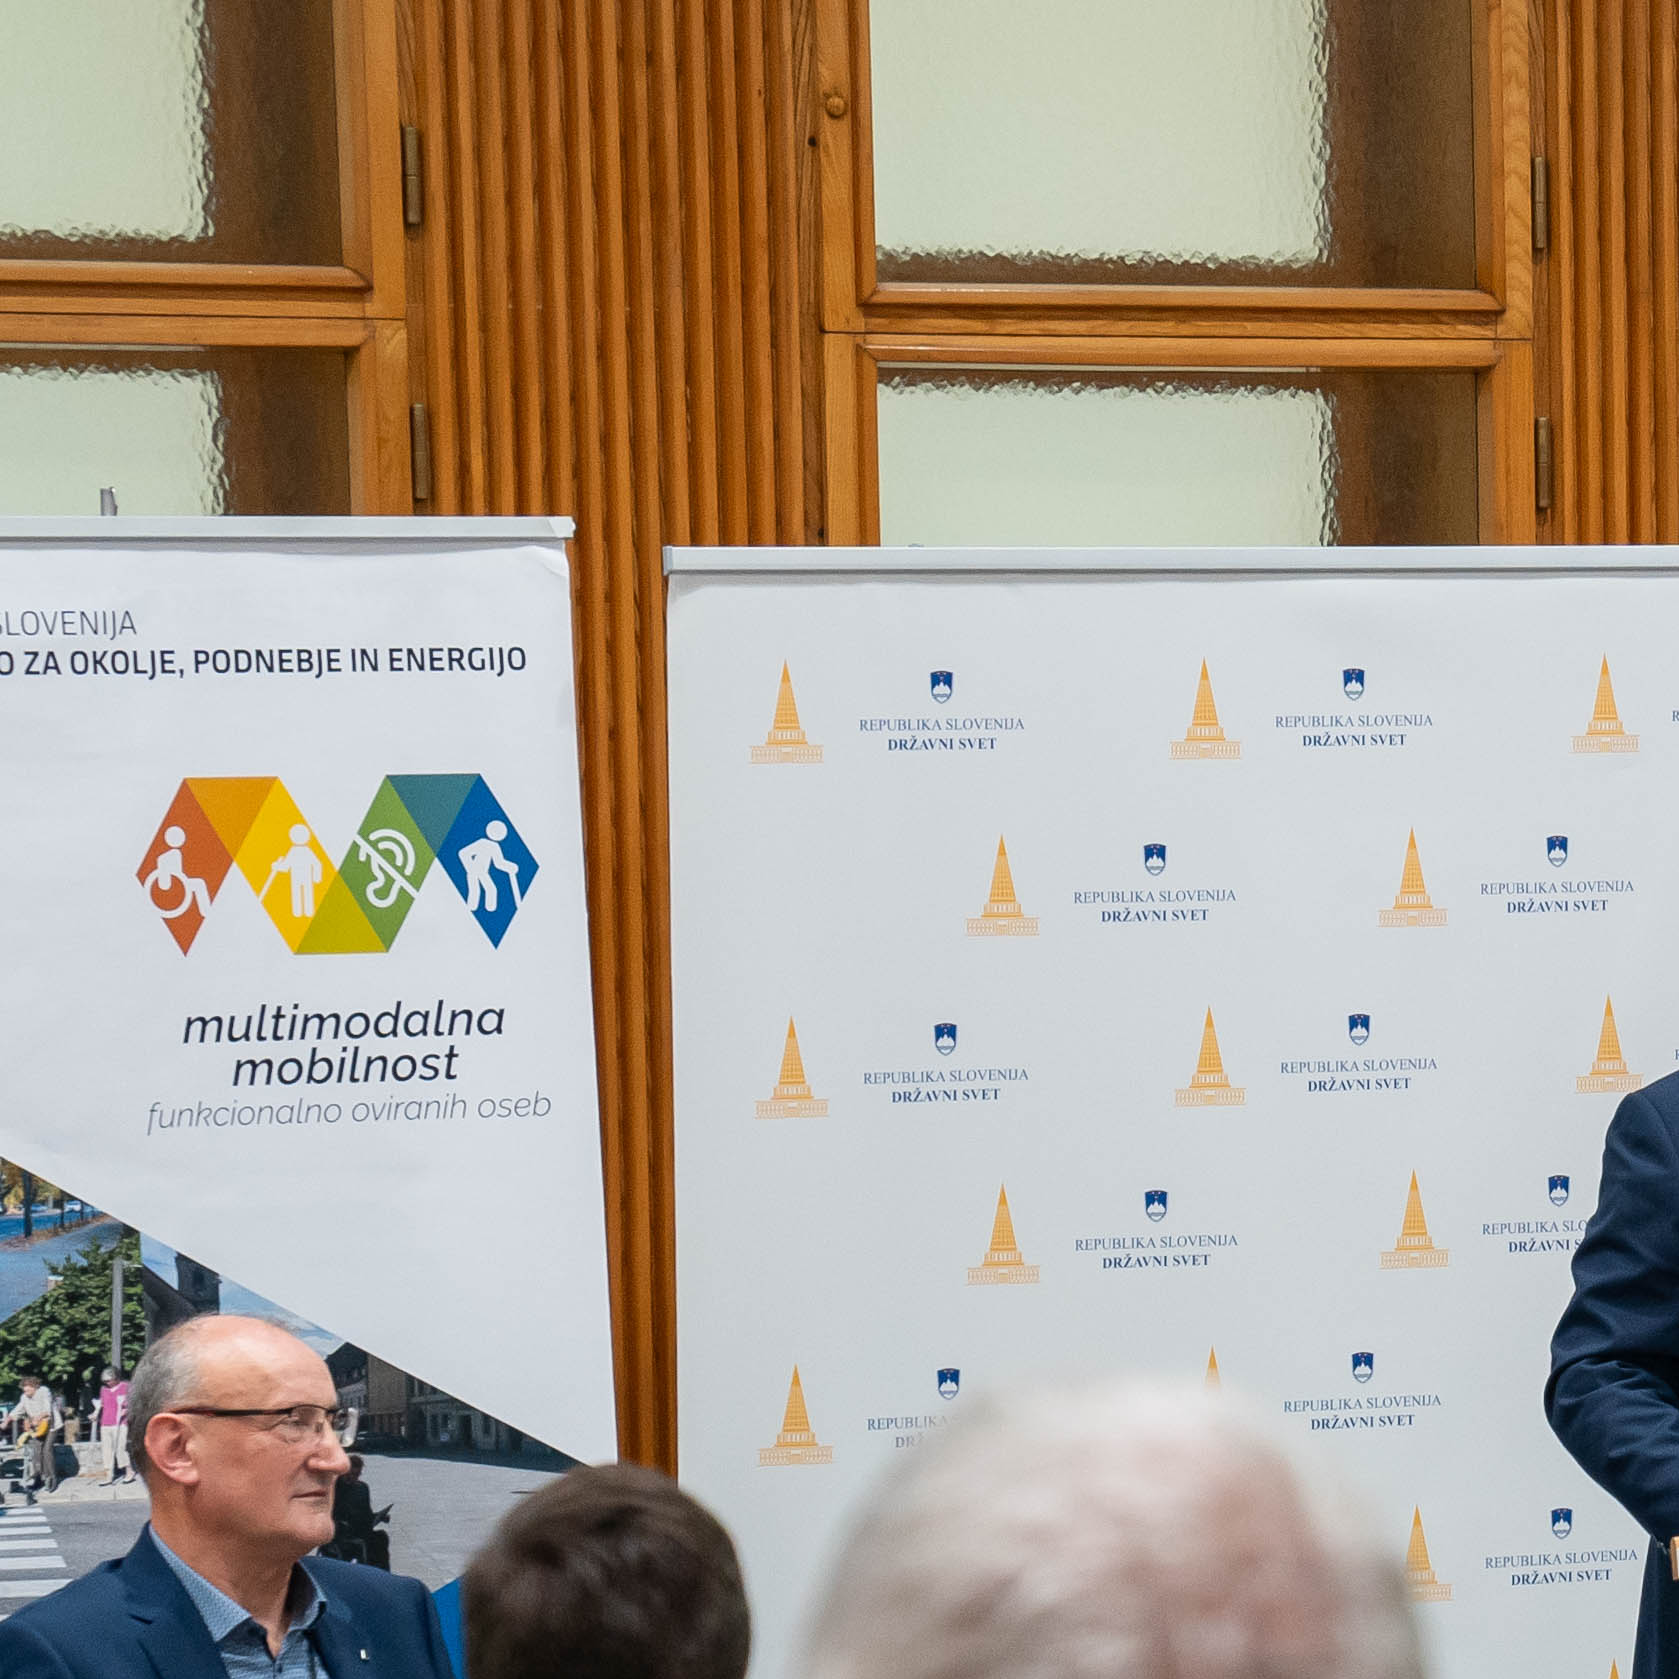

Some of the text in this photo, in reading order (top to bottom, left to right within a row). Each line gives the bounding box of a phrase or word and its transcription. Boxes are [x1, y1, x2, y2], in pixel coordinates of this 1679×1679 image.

[0, 609, 138, 641] LOVENIJA
[23, 650, 62, 676] ZA
[70, 649, 185, 681] OKOLJE,
[193, 648, 342, 679] PODNEBJE
[350, 647, 379, 673] IN
[388, 646, 527, 678] ENERGIJO
[859, 717, 1025, 732] REPUBLIKA SLOVENIJA
[1275, 713, 1433, 729] REPUBLIKA SLOVENIJA
[887, 735, 995, 751] DRŽAVNI SVET
[1302, 731, 1407, 747] DRŽAVNI SVET
[1480, 879, 1634, 896] REPUBLIKA SLOVENIJA
[1073, 889, 1237, 905] REPUBLIKA SLOVENIJA
[1507, 897, 1609, 914] DRŽAVNI SVET
[1101, 907, 1207, 923] DRŽAVNI SVET
[183, 999, 505, 1044] multimodalna
[232, 1044, 460, 1087] mobilnost
[1280, 1057, 1438, 1074] REPUBLIKA SLOVENIJA
[863, 1068, 1029, 1085] REPUBLIKA SLOVENIJA
[1308, 1076, 1409, 1093] DRŽAVNI SVET
[891, 1087, 1001, 1104] DRŽAVNI SVET
[146, 1090, 552, 1137] funkcionalno oviranih oseb
[1482, 1221, 1560, 1236] REPUBLIKA
[1075, 1234, 1238, 1252] REPUBLIKA SLOVENIJA
[1508, 1237, 1570, 1253] DRŽAVNI
[1102, 1253, 1208, 1269] DRŽAVNI SVET
[1283, 1394, 1442, 1413] REPUBLIKA SLOVENIJA
[1311, 1414, 1416, 1431] DRŽAVNI SVET
[1485, 1548, 1638, 1569] REPUBLIKA SLOVENIJA
[1511, 1568, 1610, 1586] DRŽAVNI SVET
